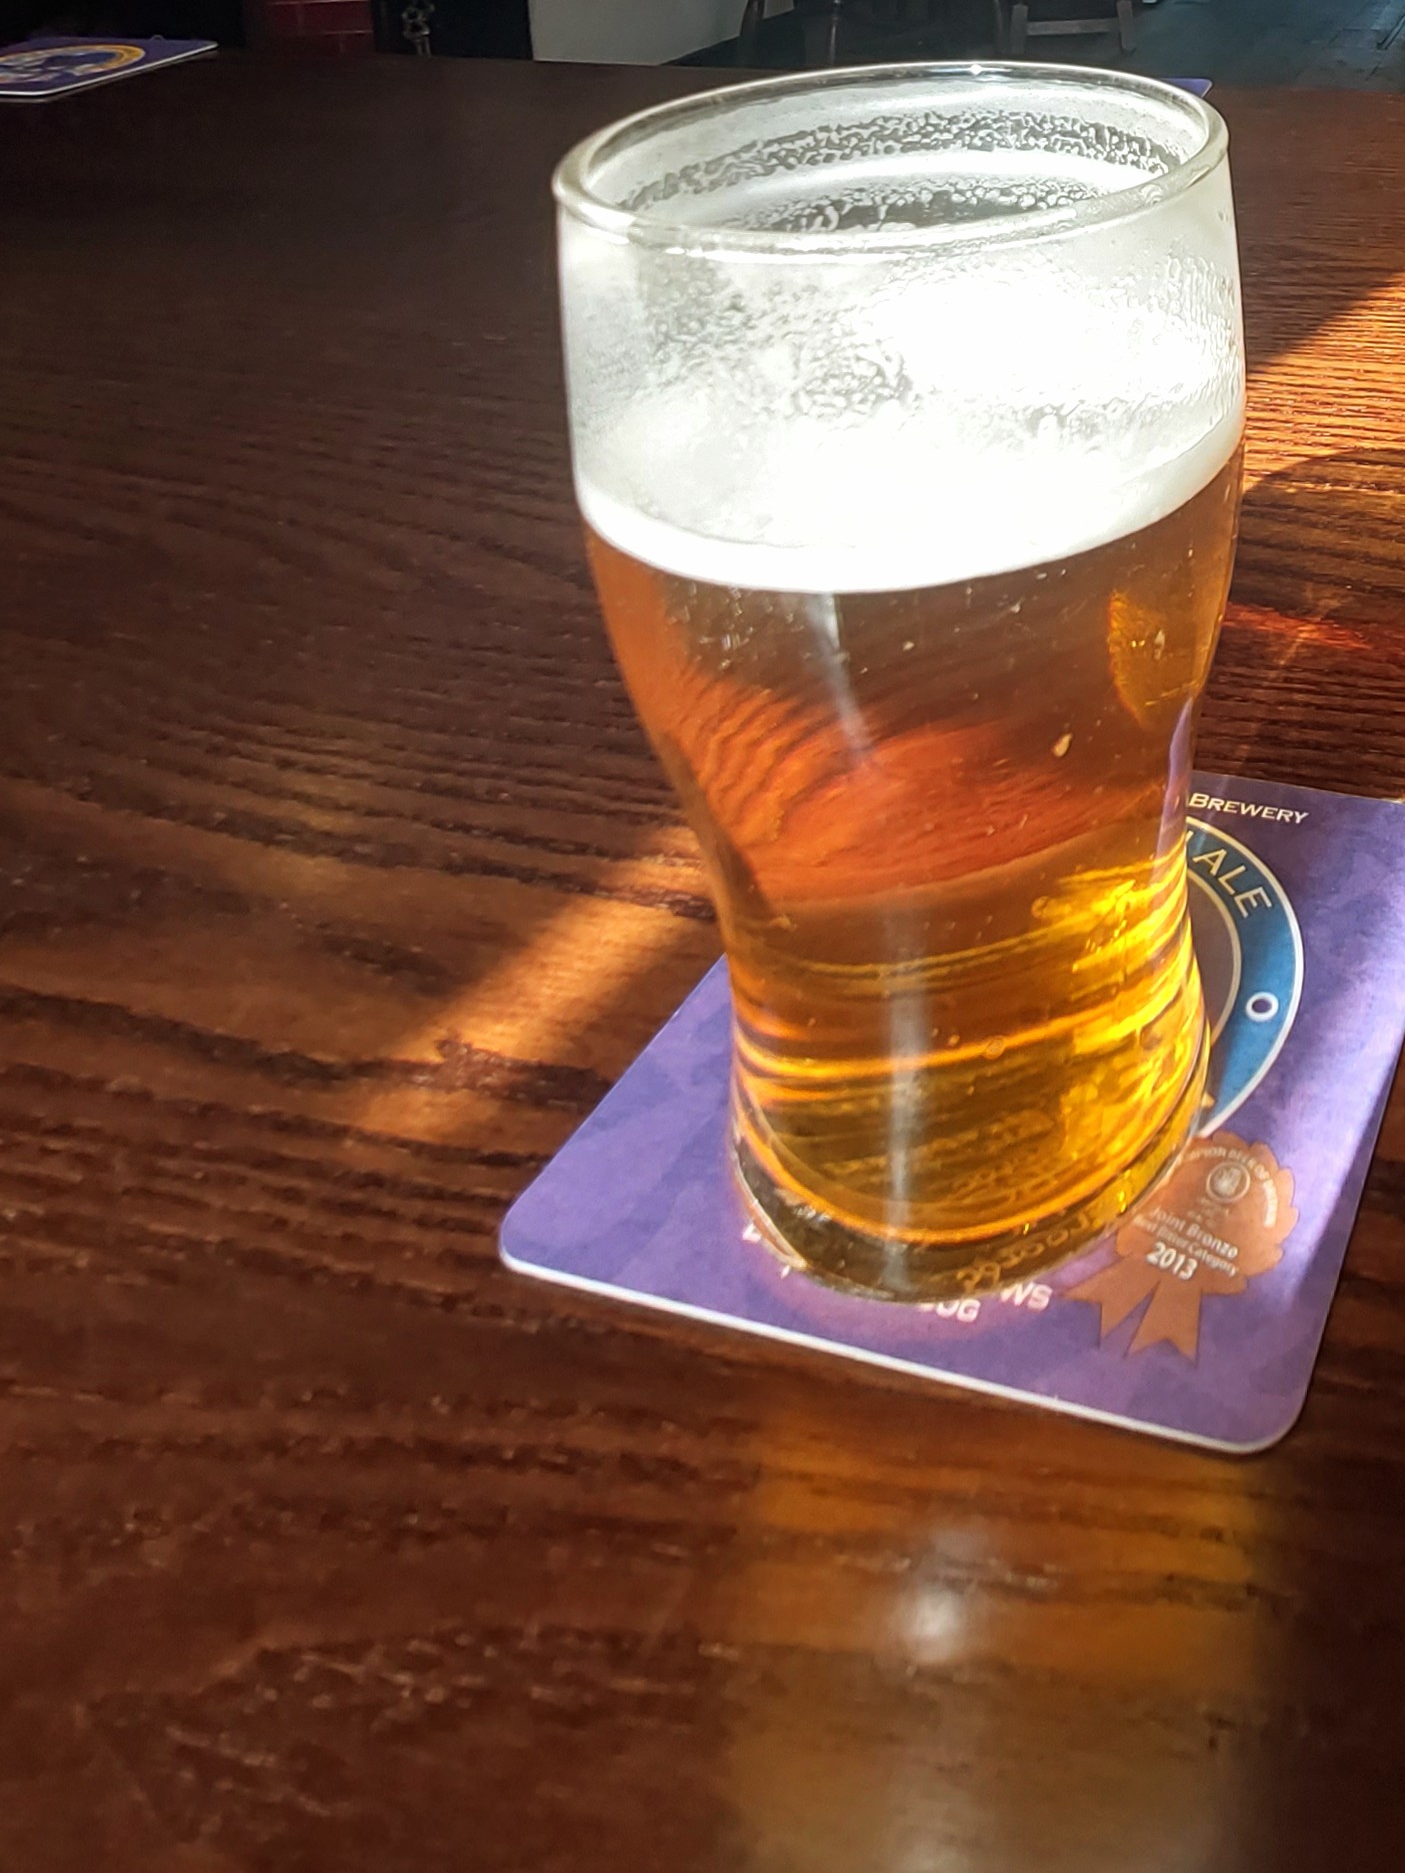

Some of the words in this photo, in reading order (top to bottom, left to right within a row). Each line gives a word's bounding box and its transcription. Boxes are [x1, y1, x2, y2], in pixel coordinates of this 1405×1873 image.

[1188, 793, 1309, 824] BREWERY
[1192, 848, 1272, 918] ALE
[1146, 1241, 1198, 1280] 2013
